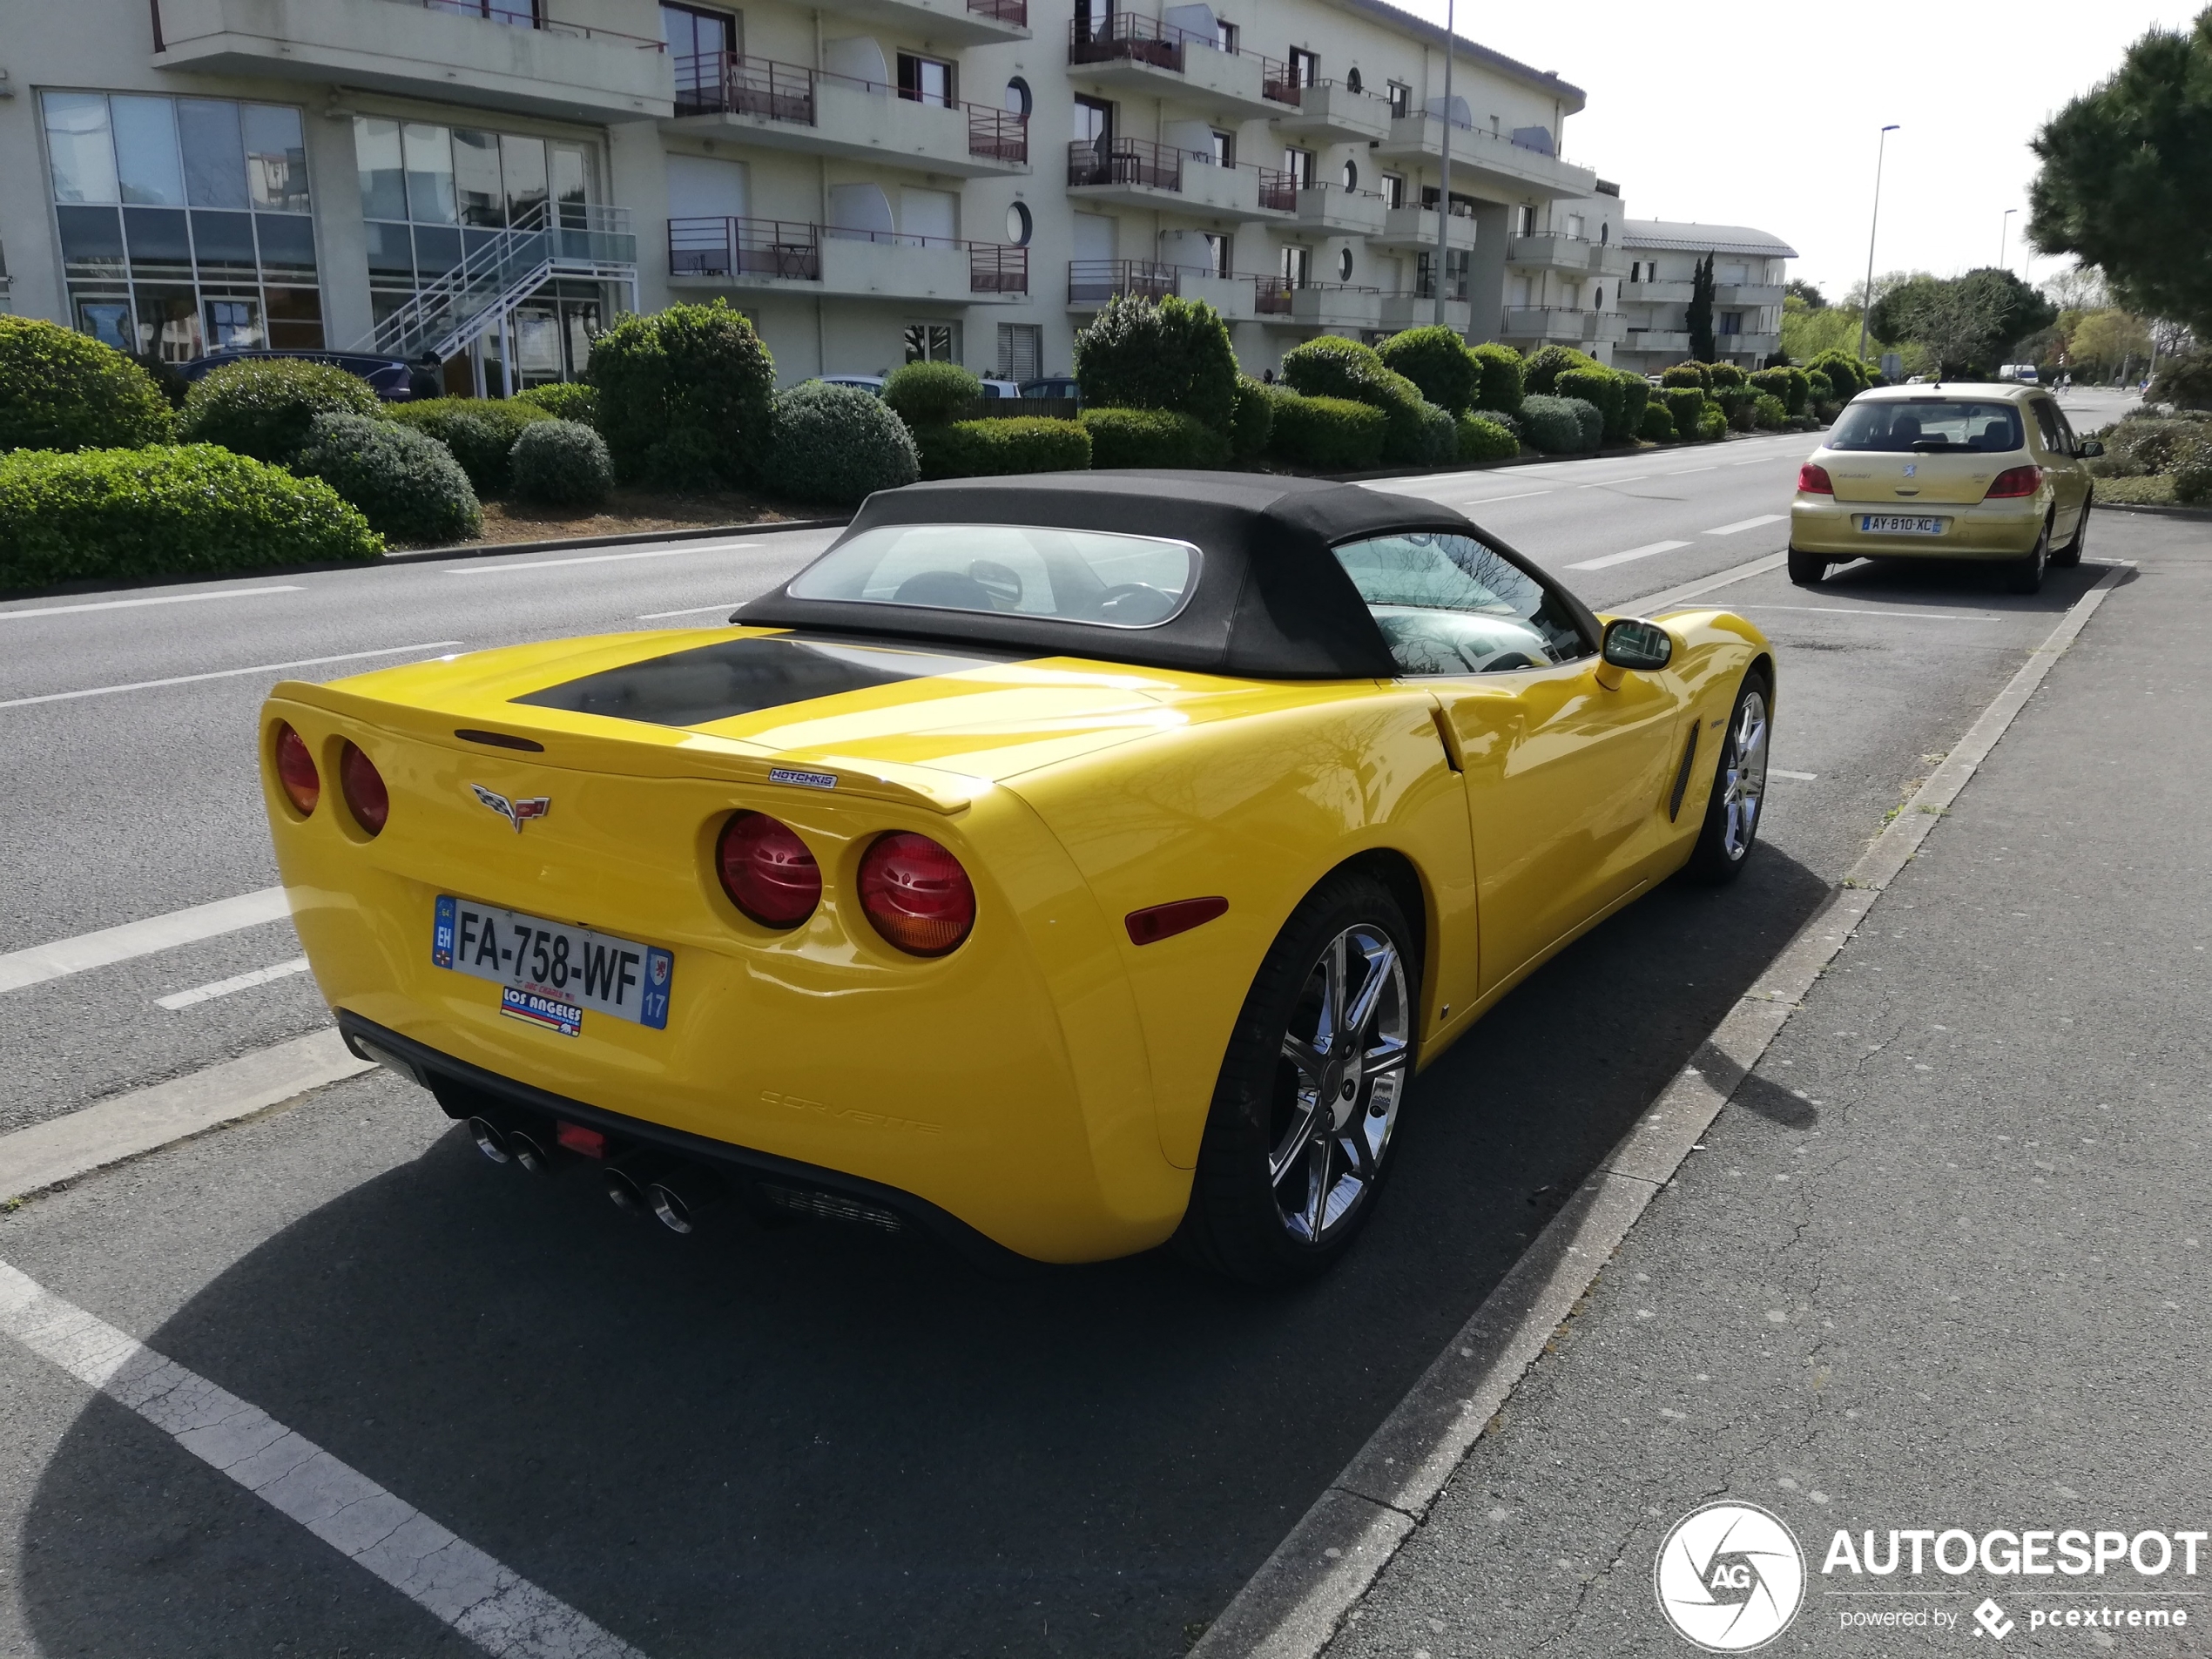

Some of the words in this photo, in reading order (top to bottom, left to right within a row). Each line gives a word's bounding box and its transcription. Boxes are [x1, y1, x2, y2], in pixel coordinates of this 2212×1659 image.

[1871, 517, 1932, 531] AY-810-XC
[772, 770, 833, 785] HOTCHKIS
[437, 926, 452, 949] EH
[459, 910, 640, 1006] FA-758-WF
[503, 988, 527, 1005] LOS
[529, 996, 582, 1022] ANGELES
[645, 992, 666, 1019] 17
[760, 1089, 943, 1134] CORVETTE
